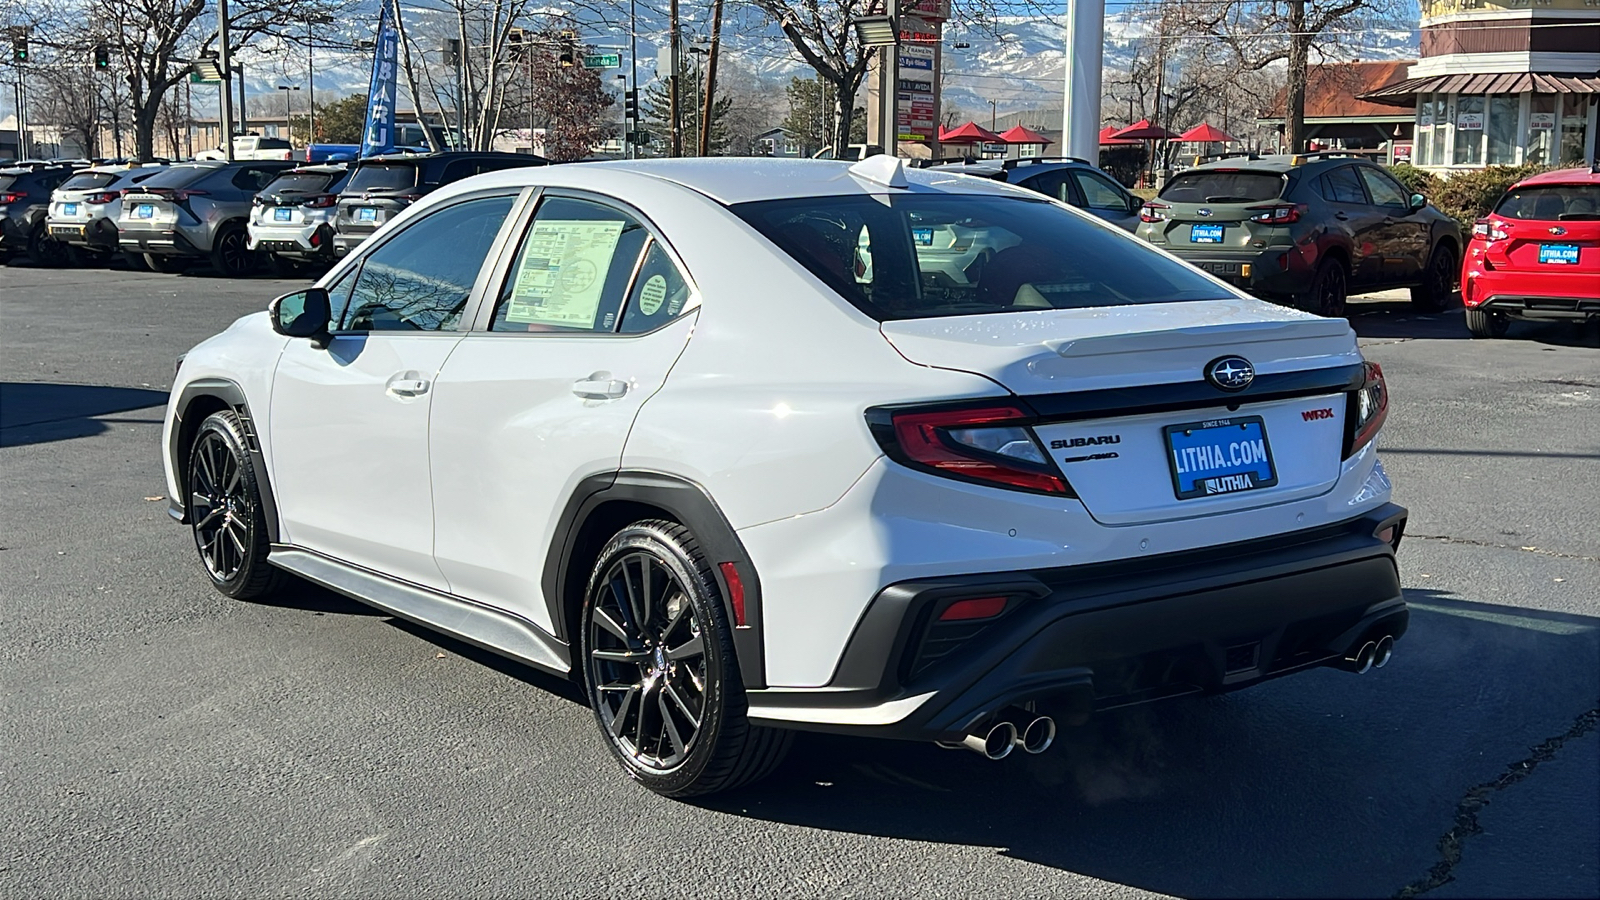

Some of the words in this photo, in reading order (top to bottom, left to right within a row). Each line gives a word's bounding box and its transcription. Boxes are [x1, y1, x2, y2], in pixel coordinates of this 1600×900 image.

[1192, 230, 1222, 238] LITHIA.COM
[1540, 250, 1578, 258] LITHIA.COM
[1301, 408, 1334, 422] WRX
[1203, 420, 1218, 428] SINCE
[1050, 434, 1120, 449] SUBARU
[1086, 452, 1119, 461] AWD
[1174, 438, 1268, 474] LITHIA.COM
[1216, 474, 1253, 492] LITHIA
